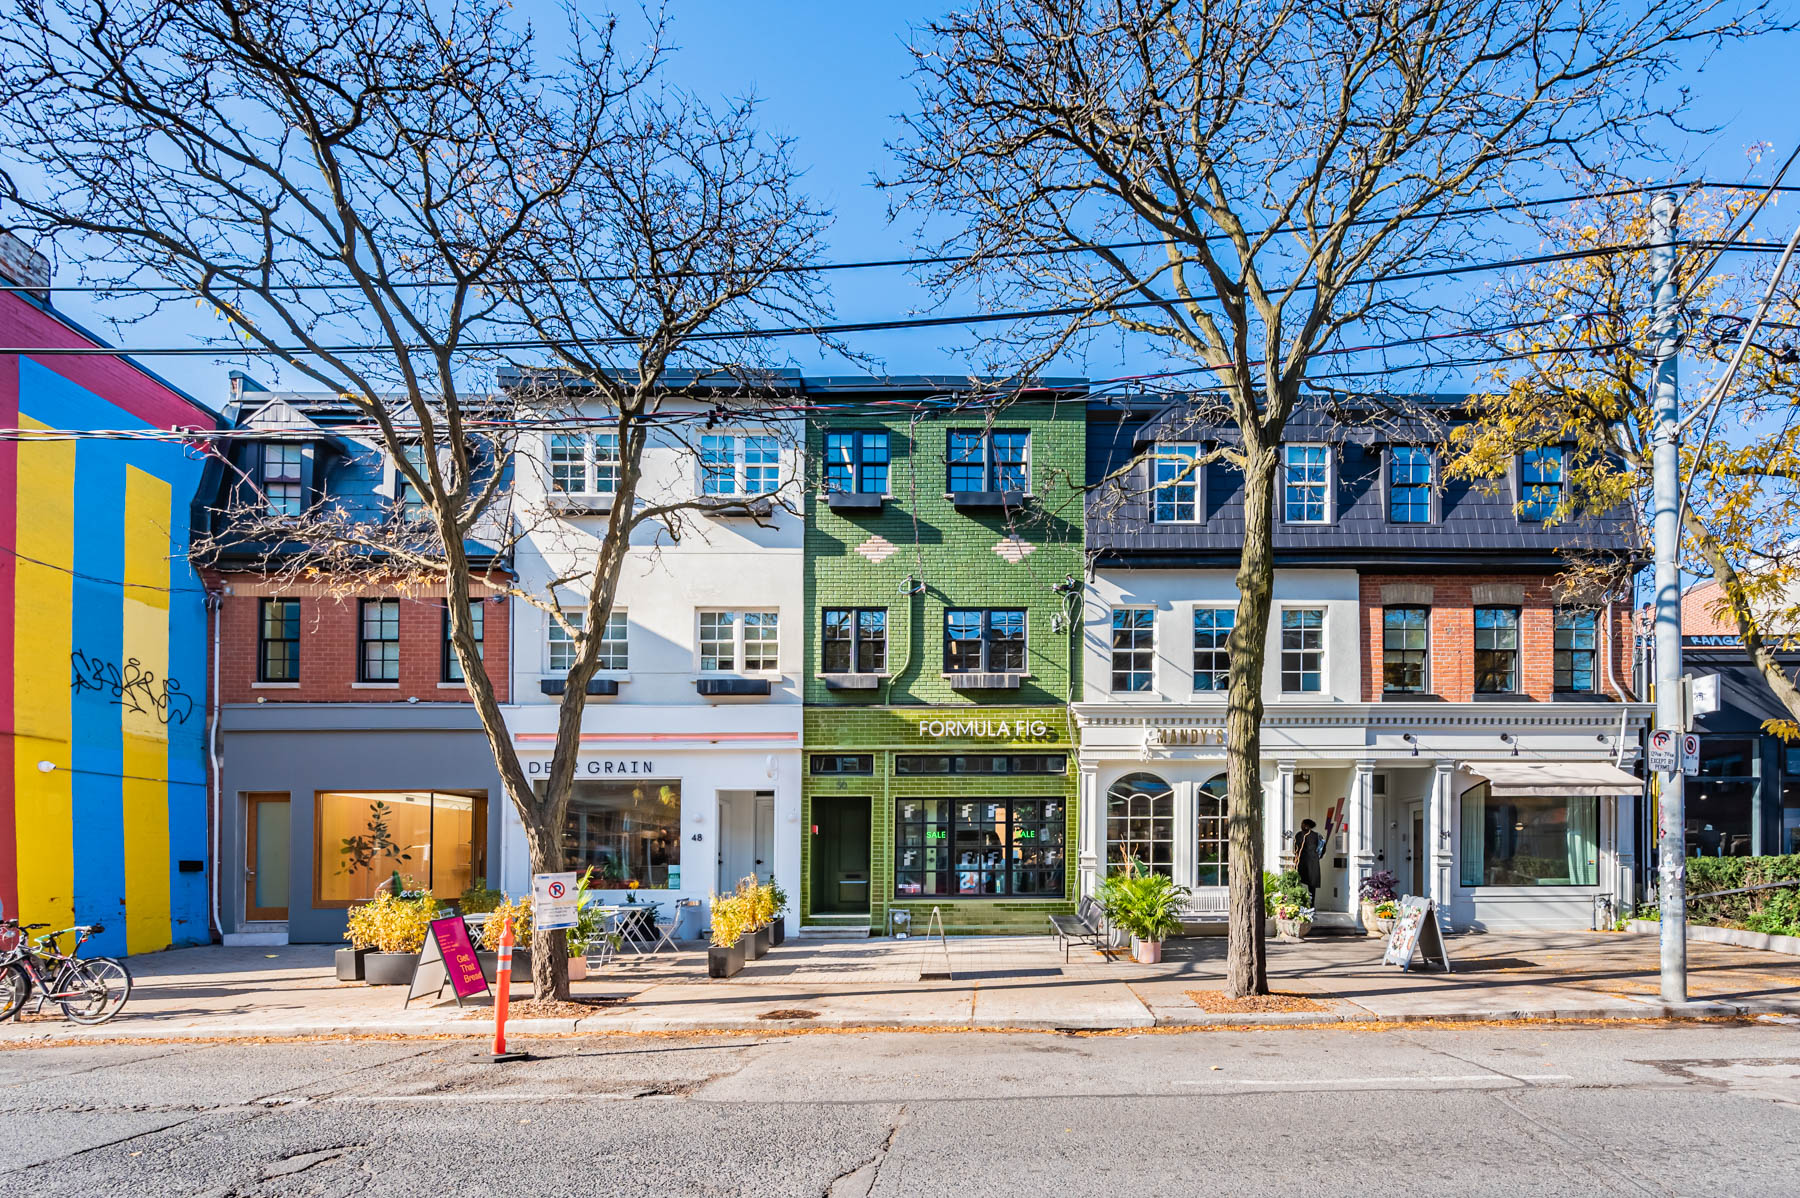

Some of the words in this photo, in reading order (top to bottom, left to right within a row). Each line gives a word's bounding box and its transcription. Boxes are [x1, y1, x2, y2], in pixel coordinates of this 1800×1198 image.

[919, 720, 1011, 737] FORMULA
[1016, 720, 1047, 737] FIG
[1156, 728, 1225, 744] MANDY'S
[587, 761, 653, 774] GRAIN
[691, 833, 703, 842] 48
[926, 831, 947, 839] SALE
[456, 953, 471, 964] Get
[460, 963, 476, 973] That
[464, 970, 483, 983] Bread
